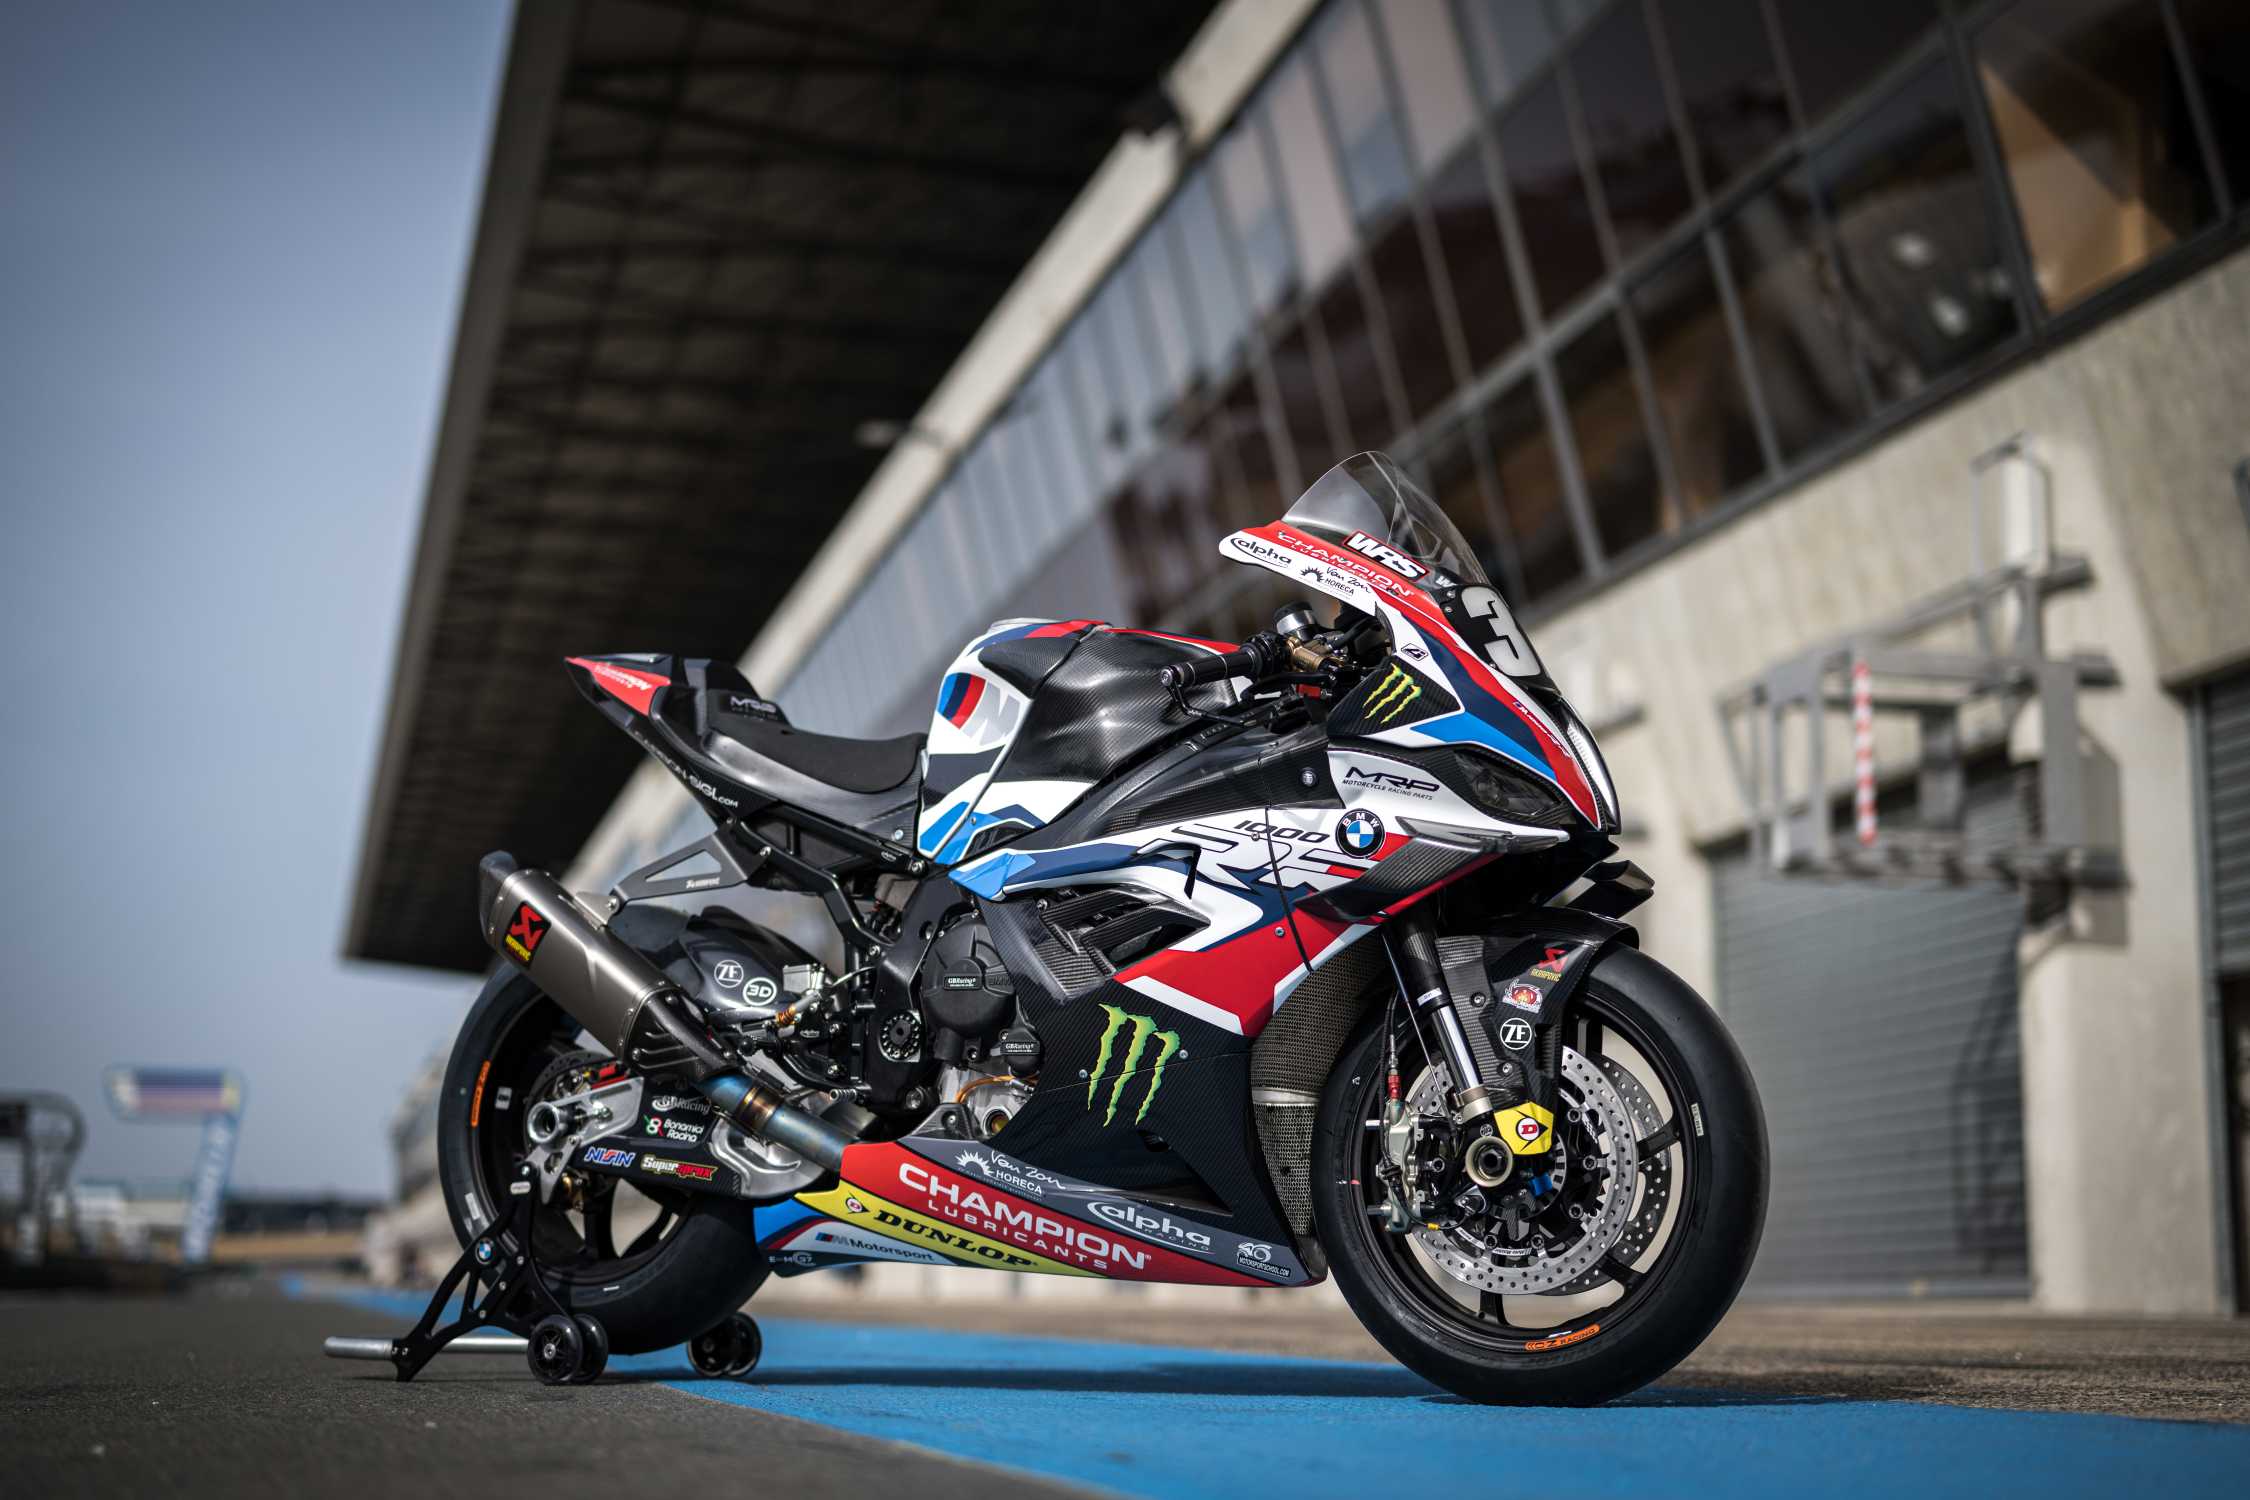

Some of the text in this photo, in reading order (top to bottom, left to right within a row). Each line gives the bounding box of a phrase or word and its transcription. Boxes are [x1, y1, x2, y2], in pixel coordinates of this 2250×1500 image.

[1237, 540, 1292, 564] alpha
[1278, 532, 1411, 597] CHAMPION
[1346, 532, 1425, 578] WRS
[1324, 578, 1355, 596] HORECA
[1461, 586, 1542, 677] 3
[1342, 779, 1433, 801] MOTORCYCLE RACING PARTS
[1345, 766, 1440, 792] MRP
[747, 984, 772, 998] 3D
[991, 1150, 1019, 1173] Van
[996, 1170, 1042, 1194] HORECA
[899, 1162, 1146, 1270] CHAMPION
[1101, 1206, 1210, 1246] alpha
[874, 1210, 1035, 1267] DUNLOP
[928, 1200, 1108, 1270] LUBRICANTS
[1144, 1228, 1209, 1251] RACING
[850, 1238, 935, 1261] Motorsport
